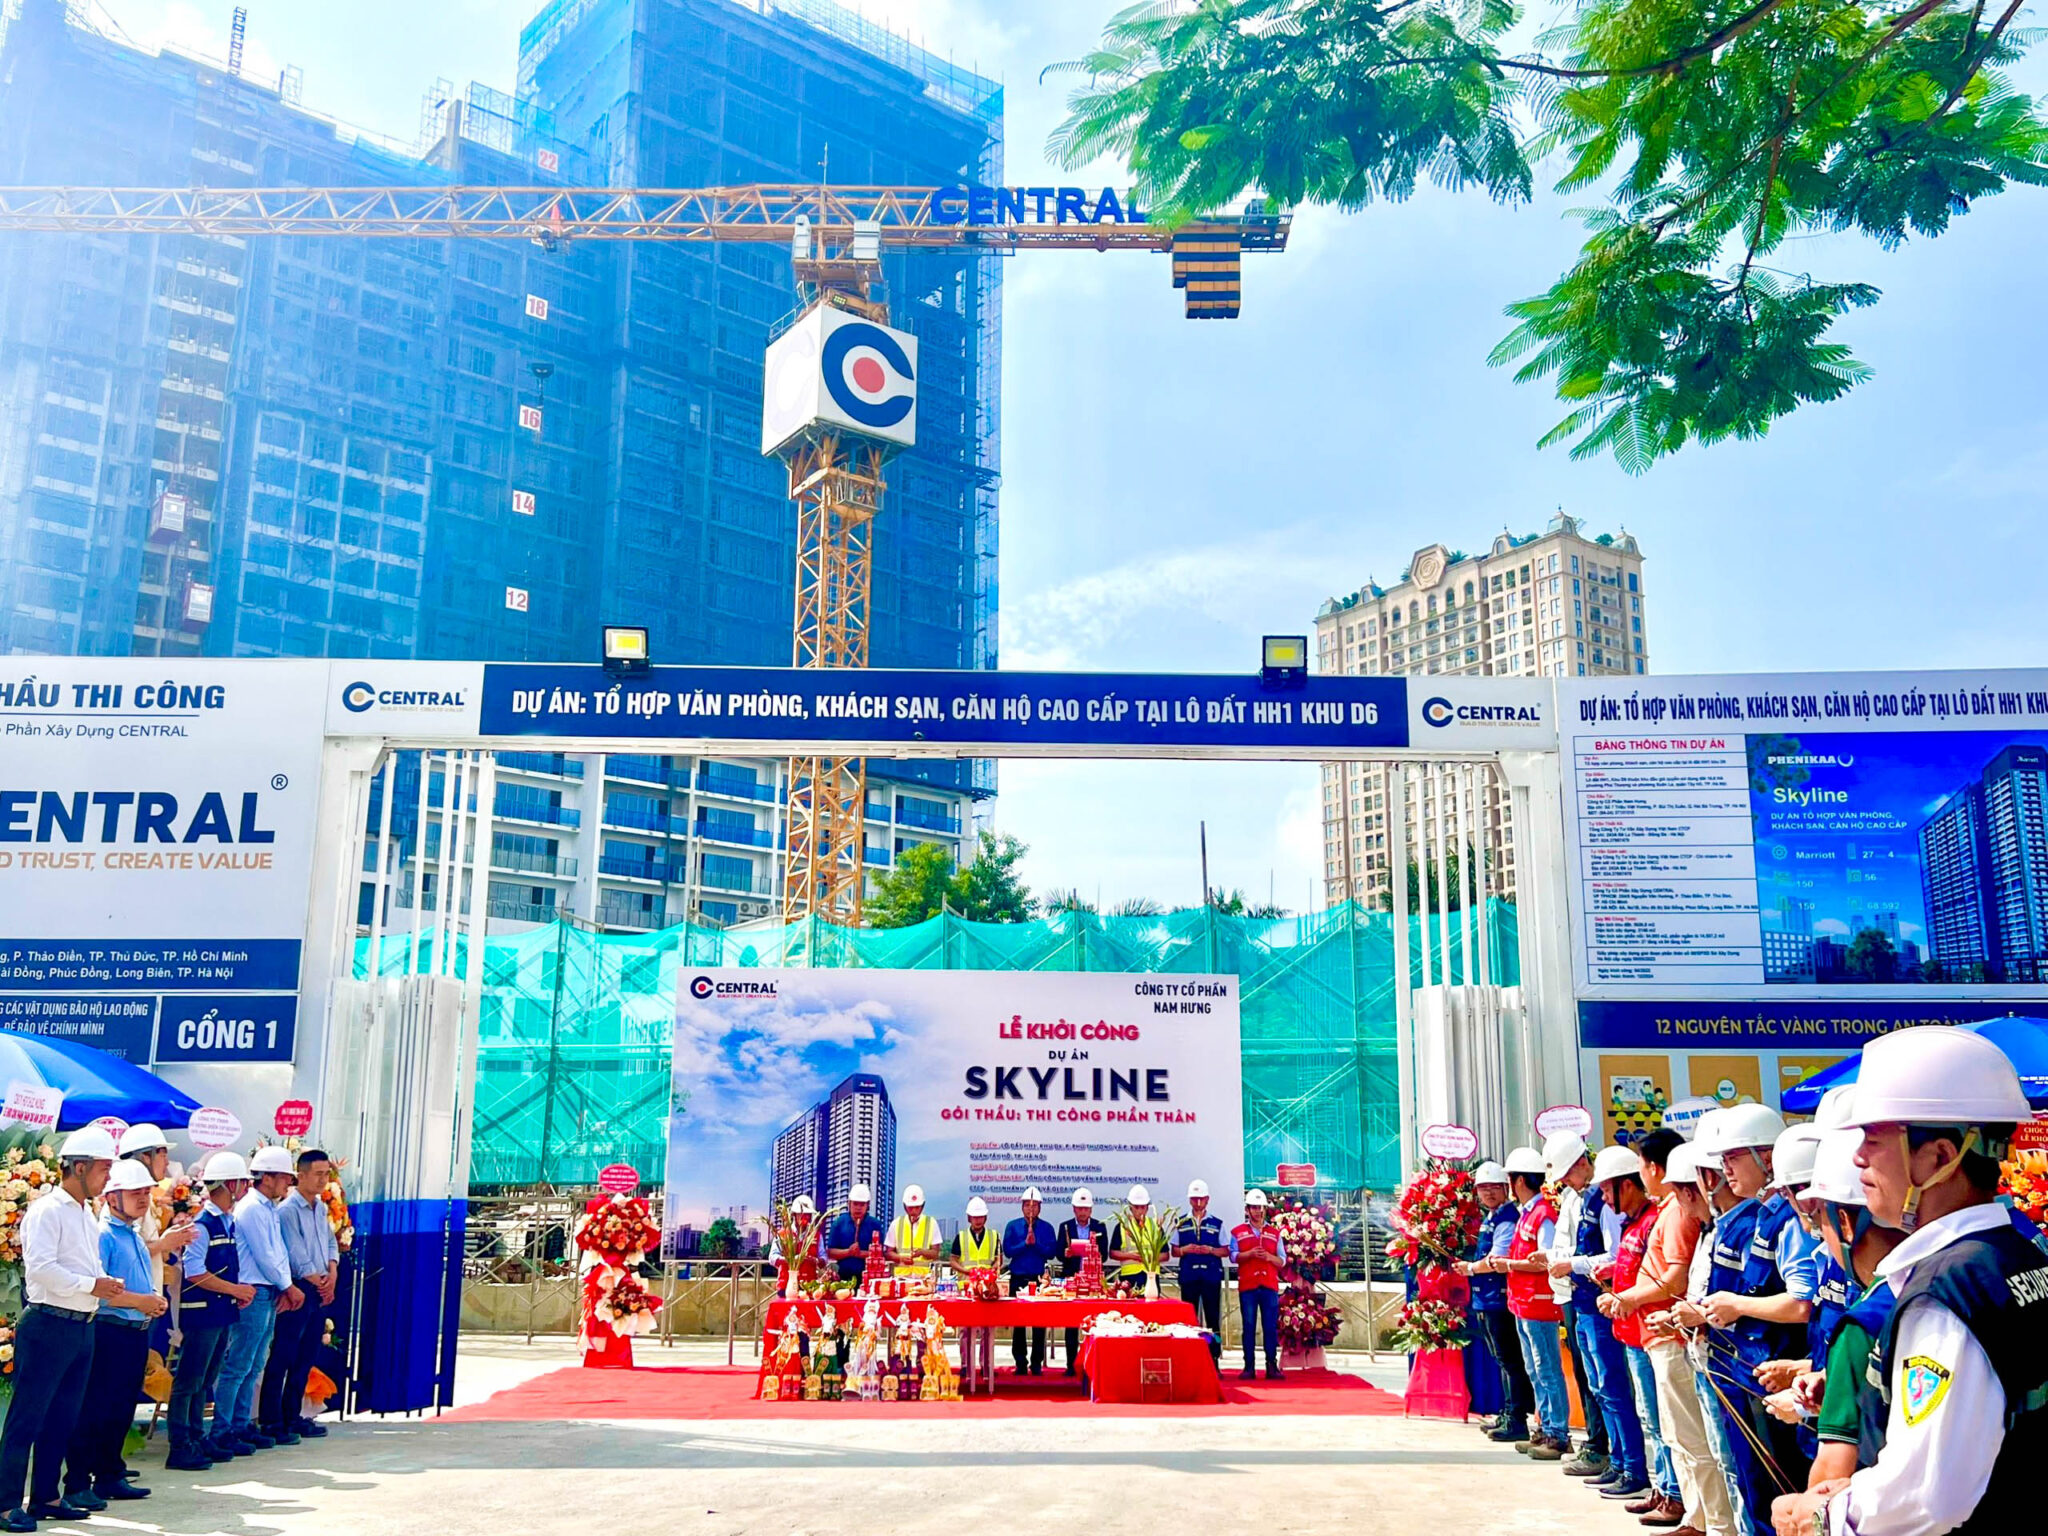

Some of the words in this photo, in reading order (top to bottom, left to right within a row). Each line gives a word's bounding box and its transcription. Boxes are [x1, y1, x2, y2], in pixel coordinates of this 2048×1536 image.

[540, 150, 556, 171] 22
[930, 186, 1147, 224] CENTRAL
[527, 298, 546, 318] 18
[521, 407, 540, 429] 16
[514, 492, 534, 513] 14
[507, 591, 527, 610] 12
[71, 684, 123, 708] THI
[134, 680, 226, 709] CÔNG
[378, 690, 465, 706] CENTRAL
[512, 690, 547, 719] DỰ
[549, 686, 587, 715] ÁN:
[593, 683, 622, 715] TỔ
[626, 692, 671, 720] HỢP
[678, 689, 724, 717] VĂN
[728, 689, 809, 721] PHÒNG,
[816, 689, 888, 719] KHÁCH
[895, 696, 945, 724] SẠN,
[952, 693, 997, 721] CĂN
[1002, 694, 1031, 726] HỘ
[1038, 698, 1080, 721] CAO
[1086, 692, 1129, 722] CẤP
[1135, 700, 1168, 728] TẠI
[1174, 694, 1200, 723] LÔ
[1206, 692, 1247, 723] ĐẤT
[1253, 701, 1293, 724] HH1
[1300, 702, 1344, 725] KHU
[1350, 702, 1378, 725] D6
[1457, 705, 1541, 721] CENTRAL
[1580, 698, 1597, 725] DỰ
[1600, 695, 1621, 720] ÁN:
[1624, 690, 1639, 720] TỔ
[1643, 696, 1667, 724] HỢP
[1670, 694, 1695, 719] VĂN
[1699, 692, 1744, 721] PHÒNG,
[1747, 692, 1789, 718] KHÁCH
[1792, 695, 1822, 722] SẠN,
[1825, 691, 1850, 717] CĂN
[1853, 691, 1871, 721] HỘ
[1874, 694, 1898, 716] CAO
[1902, 686, 1926, 716] CẤP
[1930, 693, 1950, 720] TẠI
[1952, 688, 1969, 715] LÔ
[1972, 686, 1995, 715] ĐẤT
[1998, 692, 2022, 714] HH1
[6, 721, 41, 736] Phần
[45, 723, 72, 739] Xây
[76, 725, 114, 740] Dựng
[118, 725, 189, 737] CENTRAL
[1670, 740, 1687, 749] TIN
[1767, 755, 1837, 765] PHENIKAA
[1773, 787, 1848, 807] Skyline
[18, 852, 96, 871] TRUST,
[104, 852, 194, 869] CREATE
[198, 852, 273, 870] VALUE
[28, 950, 55, 962] Thảo
[89, 951, 107, 962] TP.
[162, 951, 180, 962] TP.
[201, 950, 222, 962] Chí
[225, 951, 249, 962] Minh
[49, 967, 78, 979] Phúc
[115, 968, 144, 981] Long
[147, 967, 174, 980] Biên,
[178, 968, 195, 978] TP.
[198, 966, 213, 978] Hà
[215, 967, 234, 981] Nội
[716, 982, 777, 993] CENTRAL
[1135, 981, 1163, 996] CÔNG
[1166, 984, 1179, 996] TY
[5, 1000, 23, 1015] CÁC
[25, 1000, 42, 1018] VẬT
[43, 1002, 68, 1018] DỤNG
[89, 1001, 103, 1018] HỘ
[104, 1003, 122, 1016] LAO
[123, 1001, 149, 1019] ĐỘNG
[1154, 1001, 1178, 1013] NAM
[1180, 1002, 1212, 1014] HƯNG
[50, 1020, 78, 1035] CHÍNH
[80, 1020, 105, 1036] MÌNH
[177, 1008, 255, 1050] CỔNG
[265, 1020, 278, 1049] 1
[999, 1015, 1022, 1039] LỄ
[1027, 1018, 1077, 1040] KHỞI
[1080, 1020, 1140, 1041] CÔNG
[1655, 1019, 1671, 1035] 12
[1675, 1015, 1742, 1035] NGUYÊN
[1745, 1012, 1777, 1034] TẮC
[1780, 1016, 1827, 1034] VÀNG
[1830, 1019, 1888, 1035] TRONG
[1048, 1050, 1066, 1062] DỰ
[963, 1065, 1170, 1102] SKYLINE
[1026, 1109, 1052, 1121] THI
[1056, 1107, 1101, 1122] CÔNG
